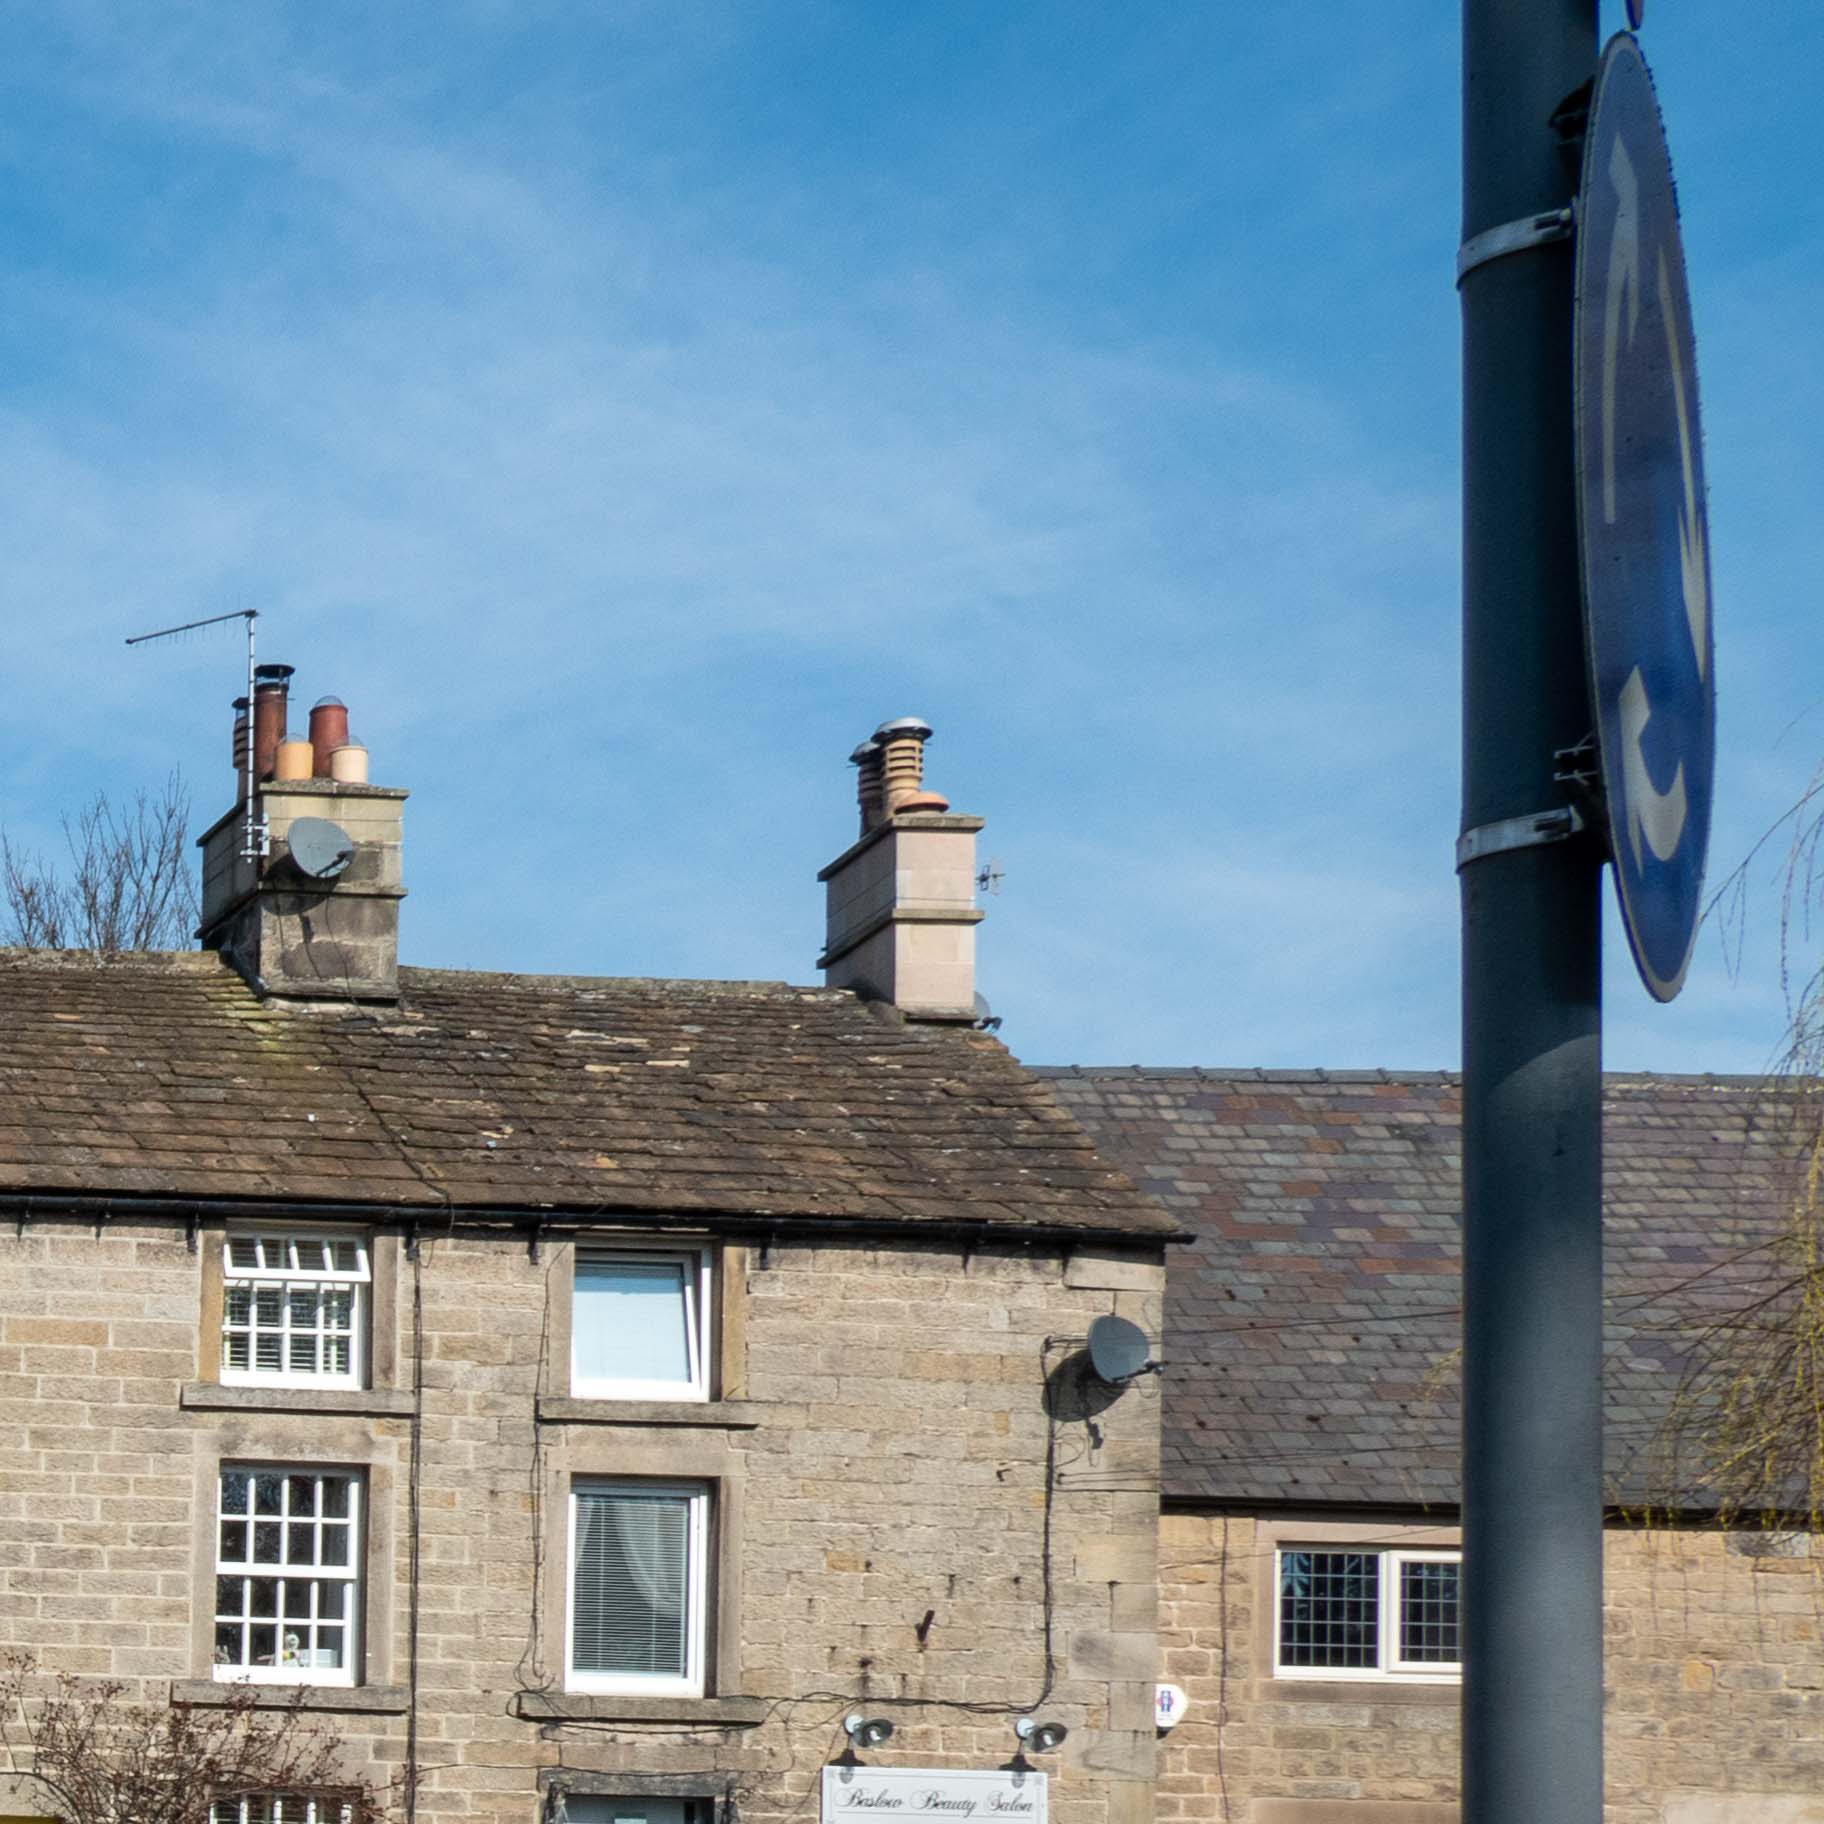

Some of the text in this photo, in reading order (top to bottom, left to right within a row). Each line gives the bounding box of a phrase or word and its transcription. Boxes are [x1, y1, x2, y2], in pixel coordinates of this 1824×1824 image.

[834, 1788, 1033, 1818] Baslow Beauty Salon
